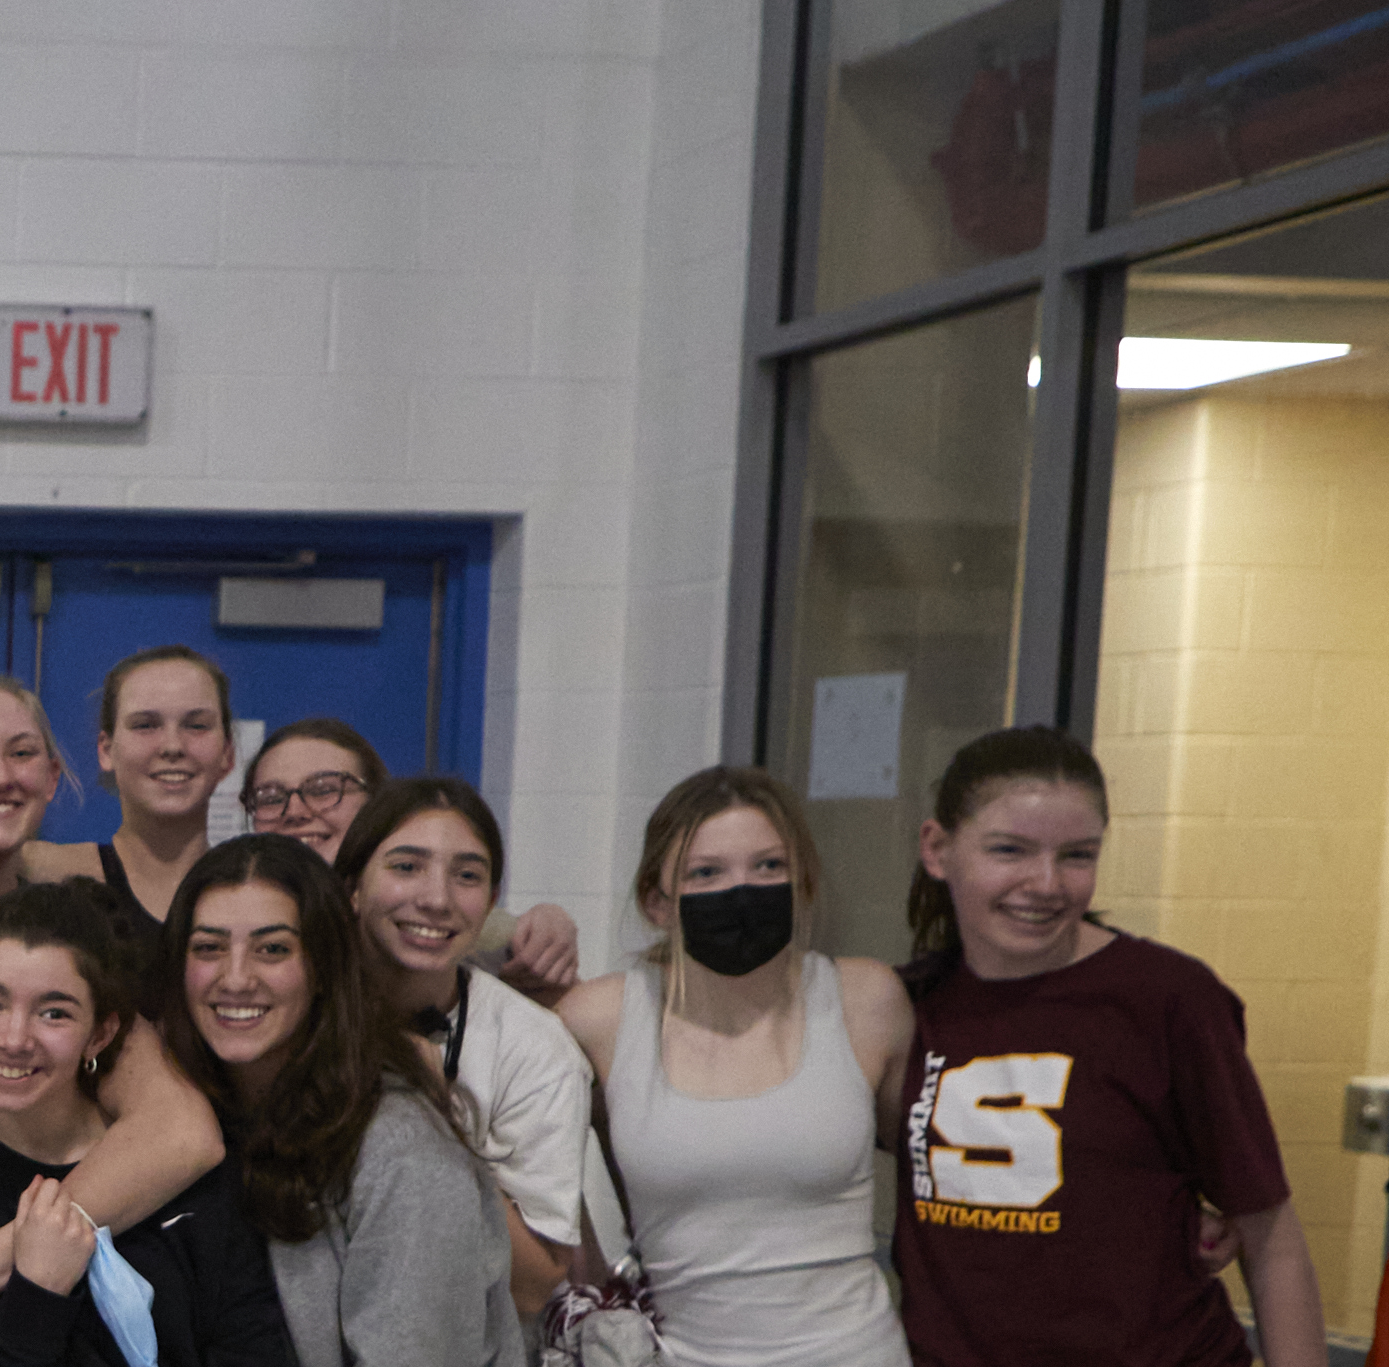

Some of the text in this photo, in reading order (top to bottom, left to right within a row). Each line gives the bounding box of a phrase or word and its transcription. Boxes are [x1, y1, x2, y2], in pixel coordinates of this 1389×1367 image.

[10, 320, 120, 404] EXIT
[908, 1050, 946, 1201] SUMMIT
[929, 1052, 1074, 1209] S
[915, 1199, 1061, 1233] SWIMMING
